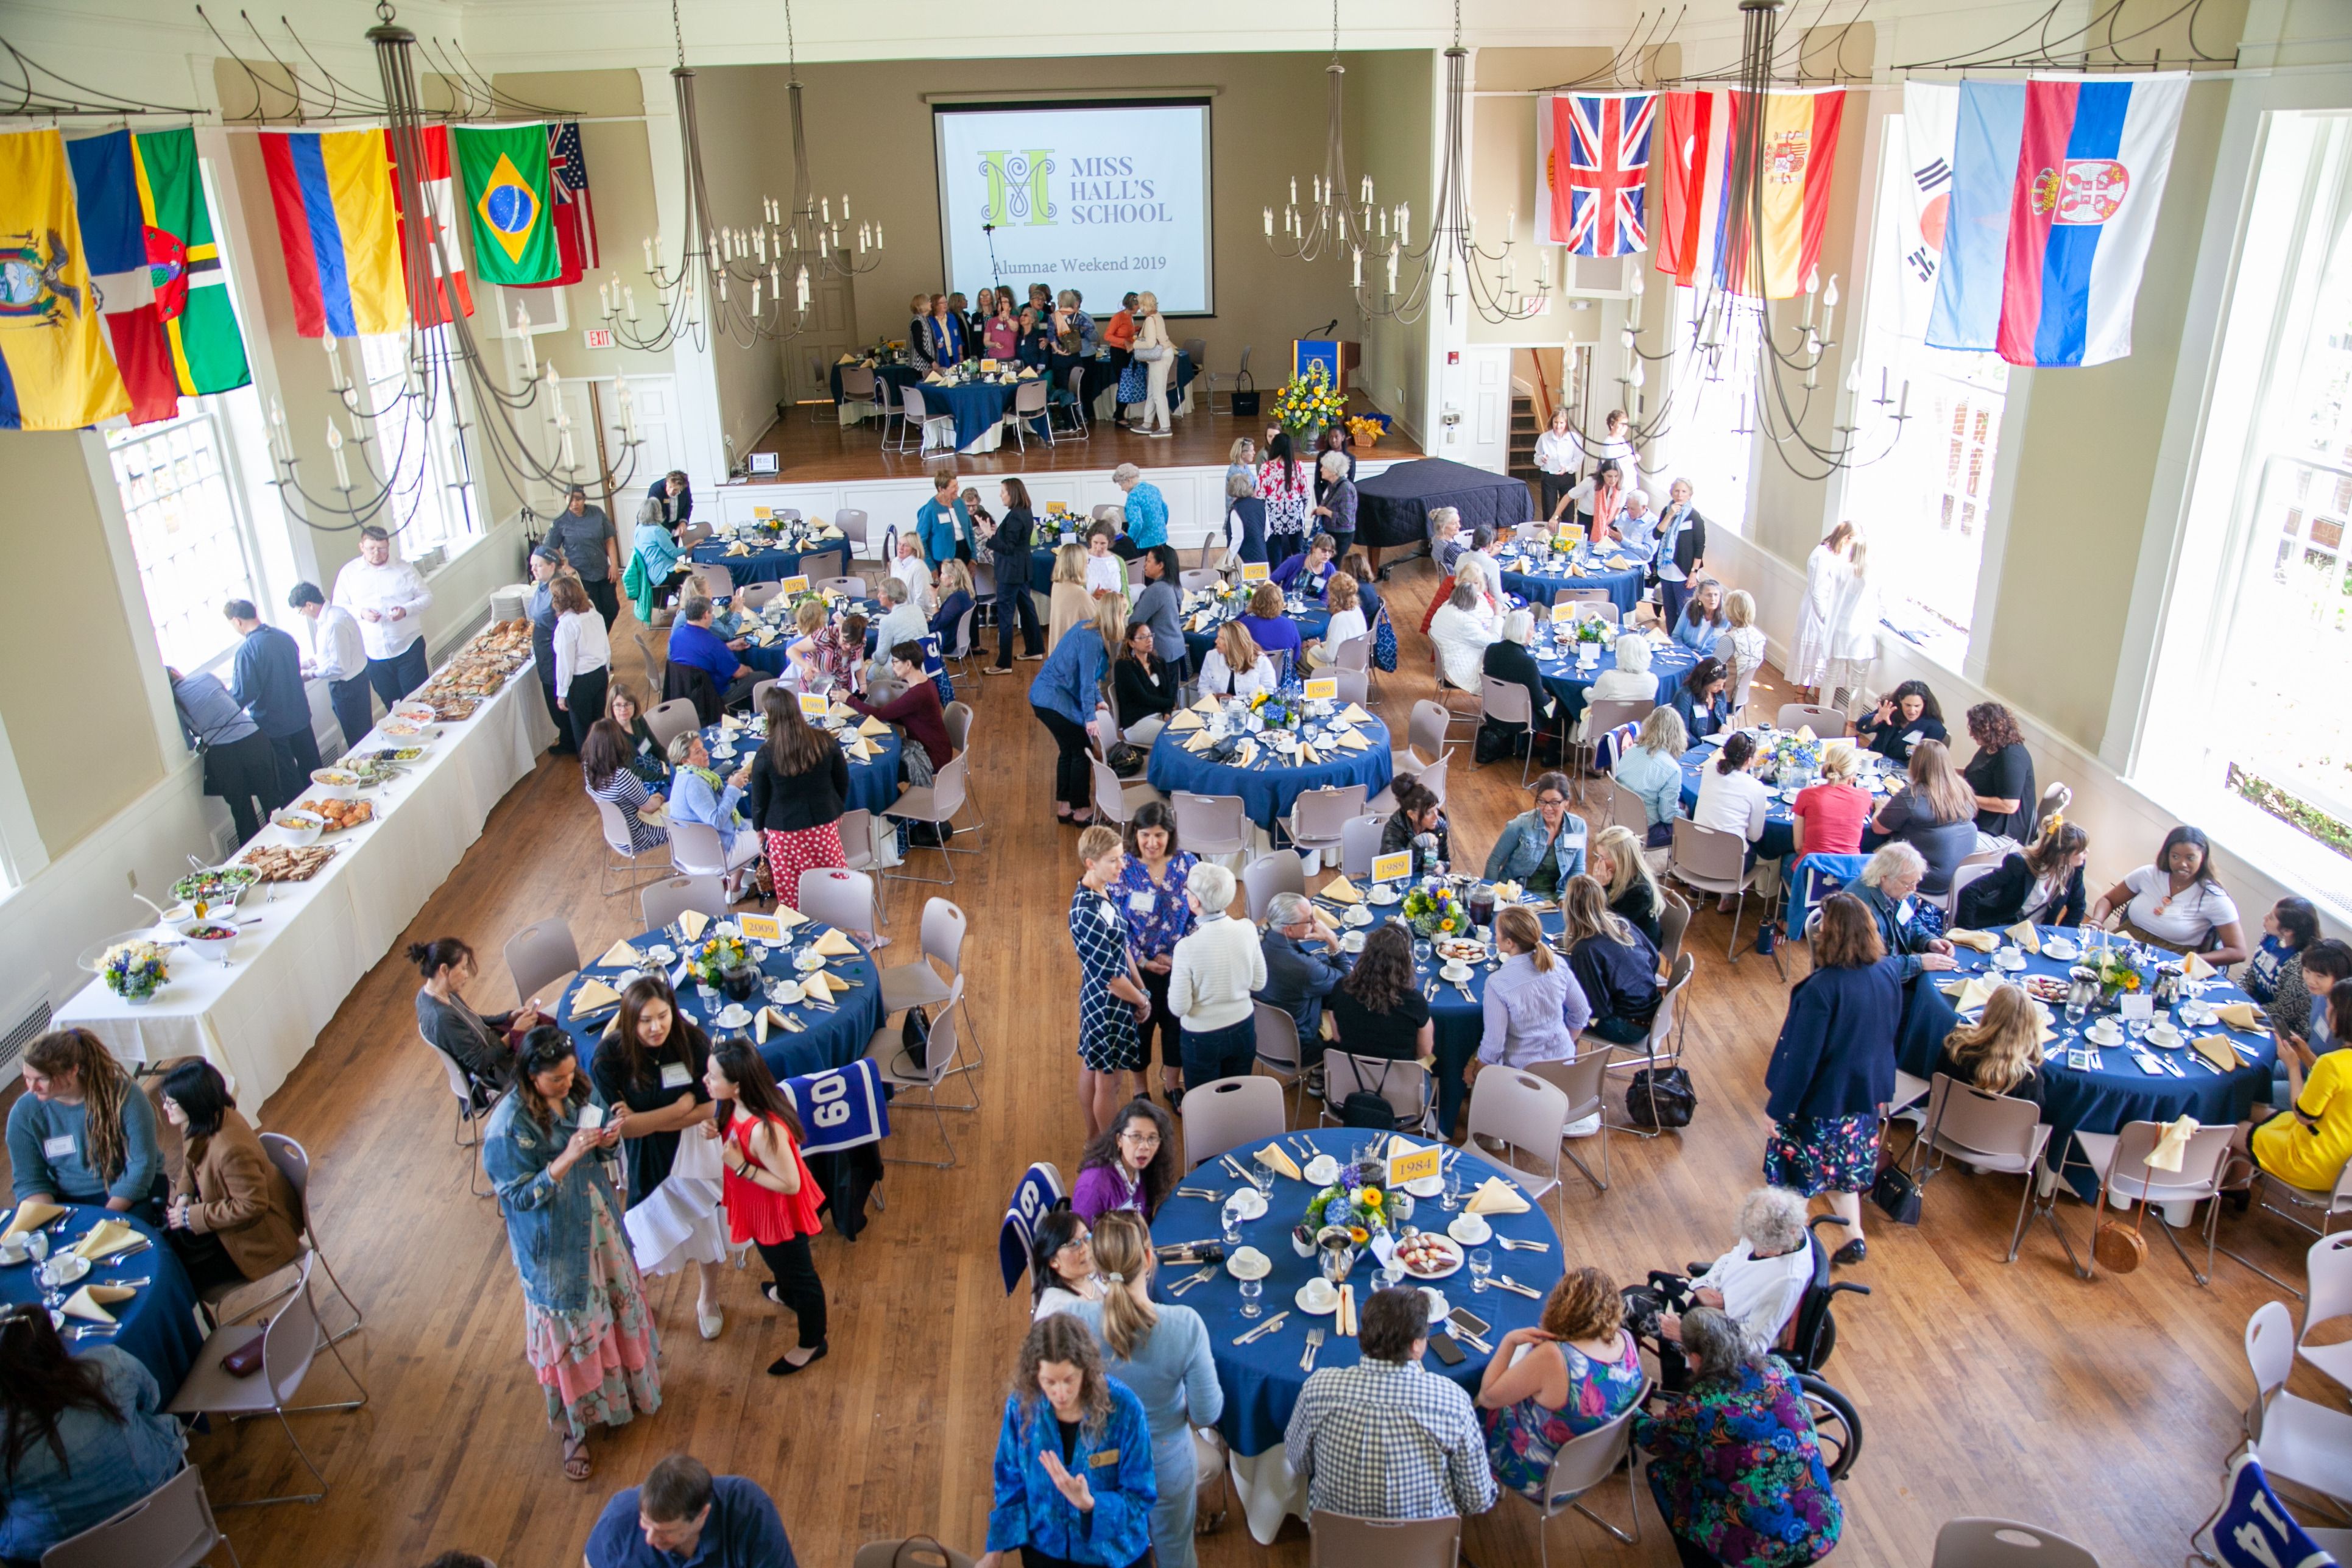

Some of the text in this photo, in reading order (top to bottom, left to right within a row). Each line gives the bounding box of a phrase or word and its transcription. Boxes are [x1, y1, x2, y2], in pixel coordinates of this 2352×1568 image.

[1070, 156, 1133, 177] MISS
[1070, 179, 1154, 201] HALL'S
[1072, 203, 1173, 224] SCHOOL
[991, 256, 1166, 275] Alumnae Weekend 2019
[590, 331, 609, 346] EXIT
[1312, 685, 1331, 694] 1989
[806, 700, 824, 709] 1989
[1381, 860, 1405, 874] 1989
[748, 922, 774, 933] 2009
[1399, 1157, 1432, 1176] 1984
[2233, 1489, 2290, 1568] 14
